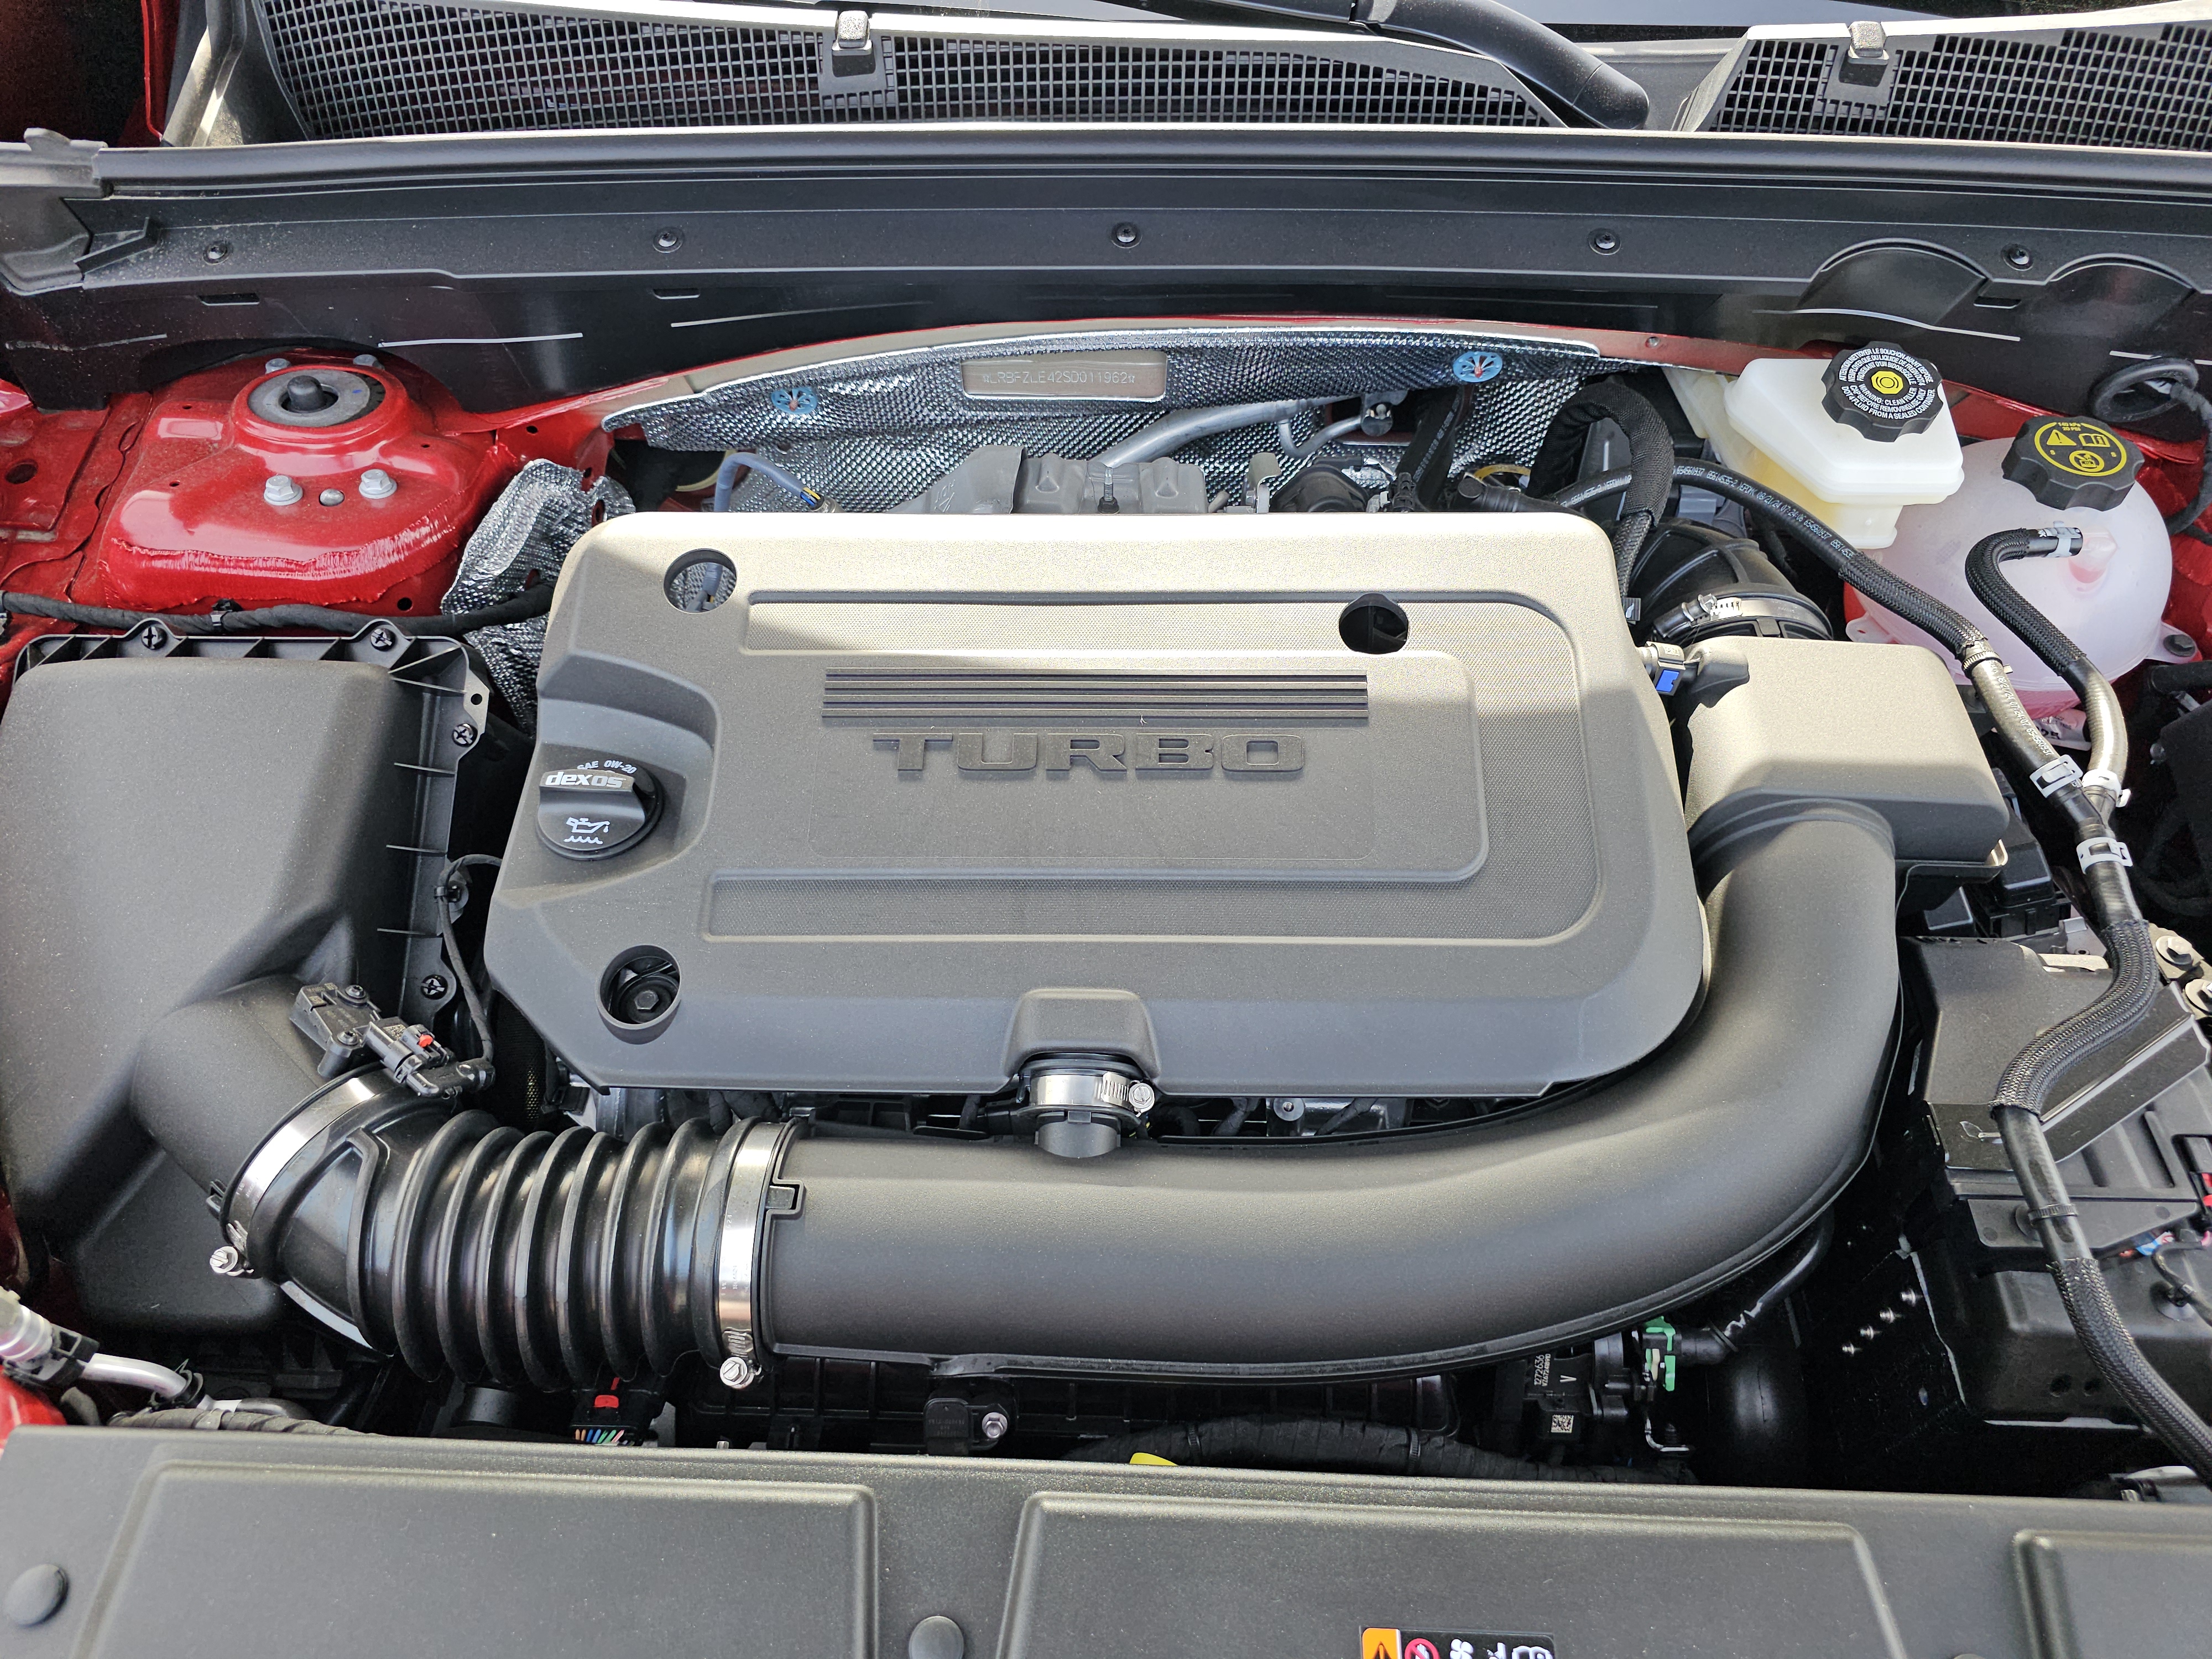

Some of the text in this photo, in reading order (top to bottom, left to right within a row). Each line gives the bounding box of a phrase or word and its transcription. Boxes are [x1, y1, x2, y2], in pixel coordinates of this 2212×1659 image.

[1879, 354, 1900, 364] LIQUIDE
[1898, 359, 1908, 367] DE
[1880, 348, 1906, 359] BOUCHON
[1904, 356, 1922, 368] AVANT
[1850, 385, 1861, 395] CAP
[1857, 393, 1881, 410] BEFORE
[1916, 388, 1927, 401] ONLY
[1885, 398, 1906, 406] CLEAN
[1903, 388, 1917, 403] FILLER
[1851, 398, 1869, 412] FLUID
[1868, 408, 1887, 418] FROM
[1893, 410, 1918, 420] SEALED
[872, 732, 1305, 773] TURBO
[577, 760, 637, 774] SAE 0W-20
[545, 771, 627, 788] dexos
